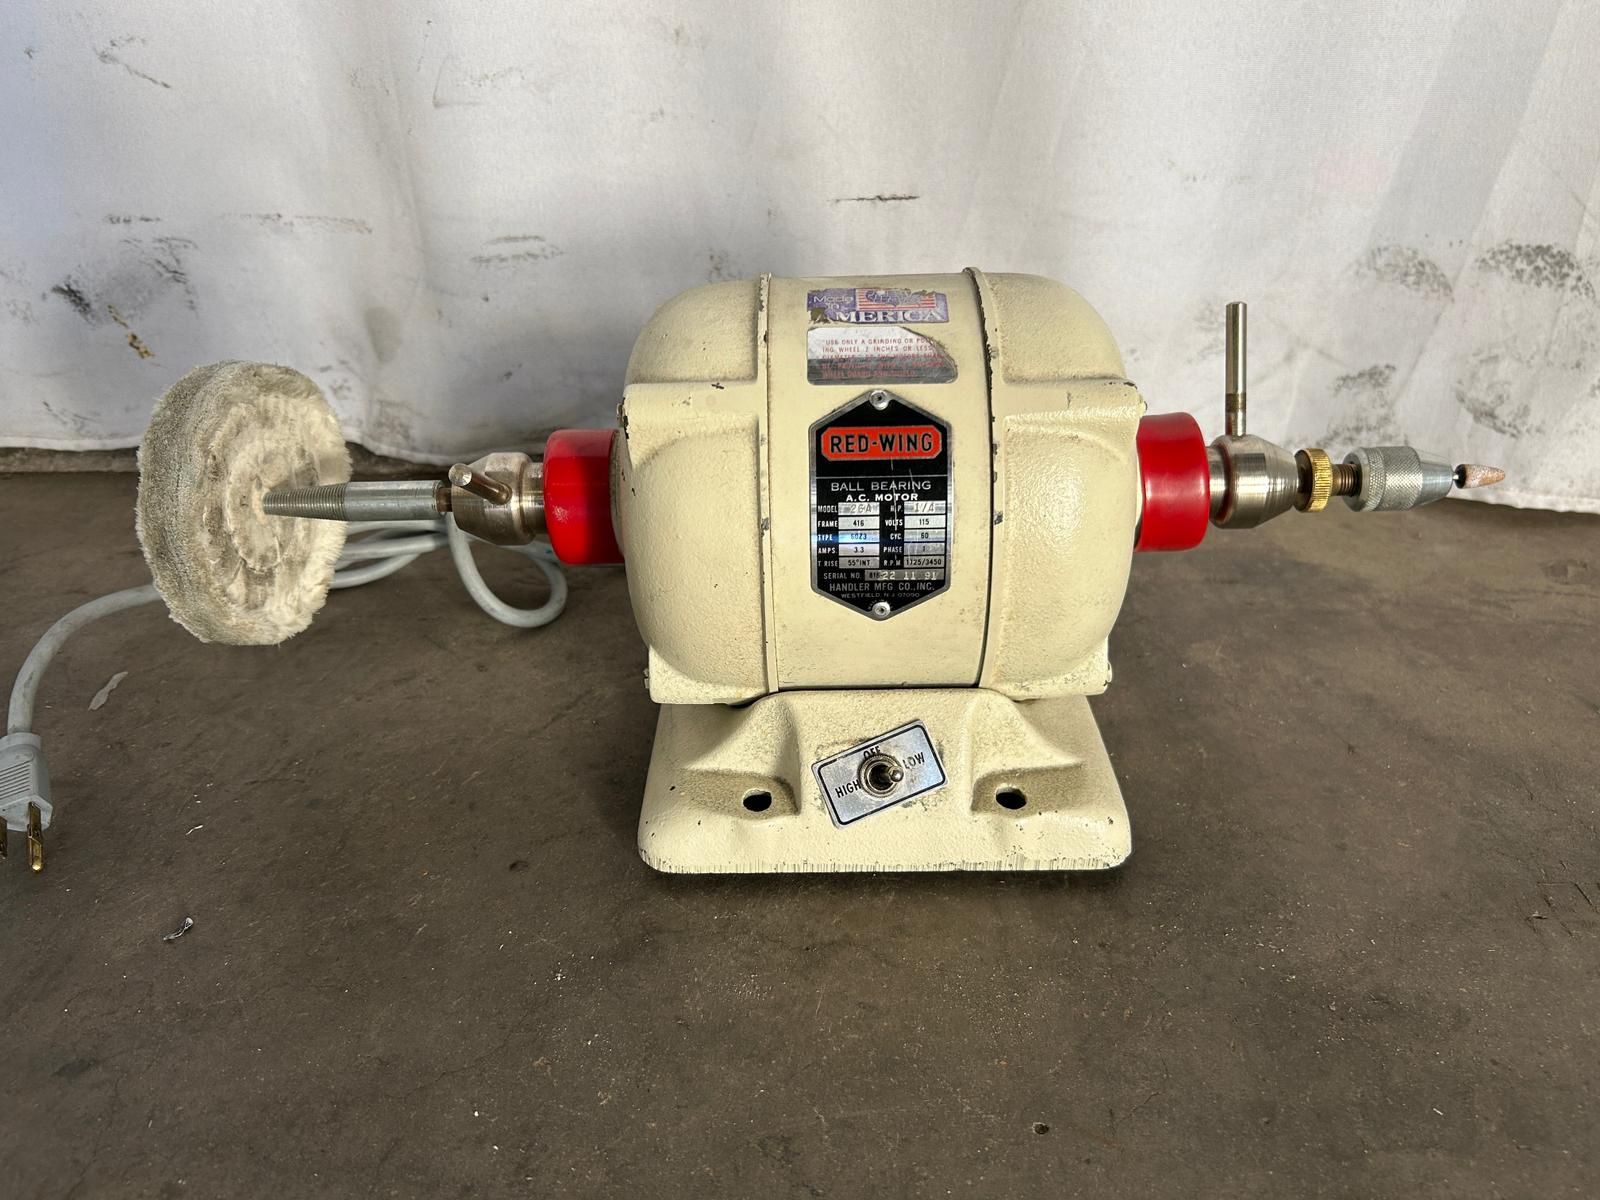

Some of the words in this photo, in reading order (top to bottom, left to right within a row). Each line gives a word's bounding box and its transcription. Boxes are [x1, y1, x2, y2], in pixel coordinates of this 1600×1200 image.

[814, 295, 854, 304] Made
[830, 433, 933, 453] RED-WING
[831, 482, 865, 492] BALL
[871, 480, 932, 491] BEARING
[845, 494, 870, 502] A.C.
[875, 492, 919, 502] MOTOR
[817, 504, 838, 513] MODEL
[914, 502, 935, 513] 1/4
[817, 520, 838, 528] FRAME
[852, 519, 865, 527] 416
[884, 519, 903, 527] VOLTS
[919, 518, 930, 526] 115
[817, 533, 833, 541] TYPE
[920, 531, 929, 539] 60
[824, 560, 838, 568] RISE
[906, 558, 942, 566] 1725/3450
[823, 572, 848, 580] SERIAL
[829, 583, 870, 592] HANDLER
[874, 583, 894, 591] MFG
[840, 592, 881, 600] WESTFIELD
[902, 752, 926, 770] LOW
[834, 779, 862, 798] HIGH
